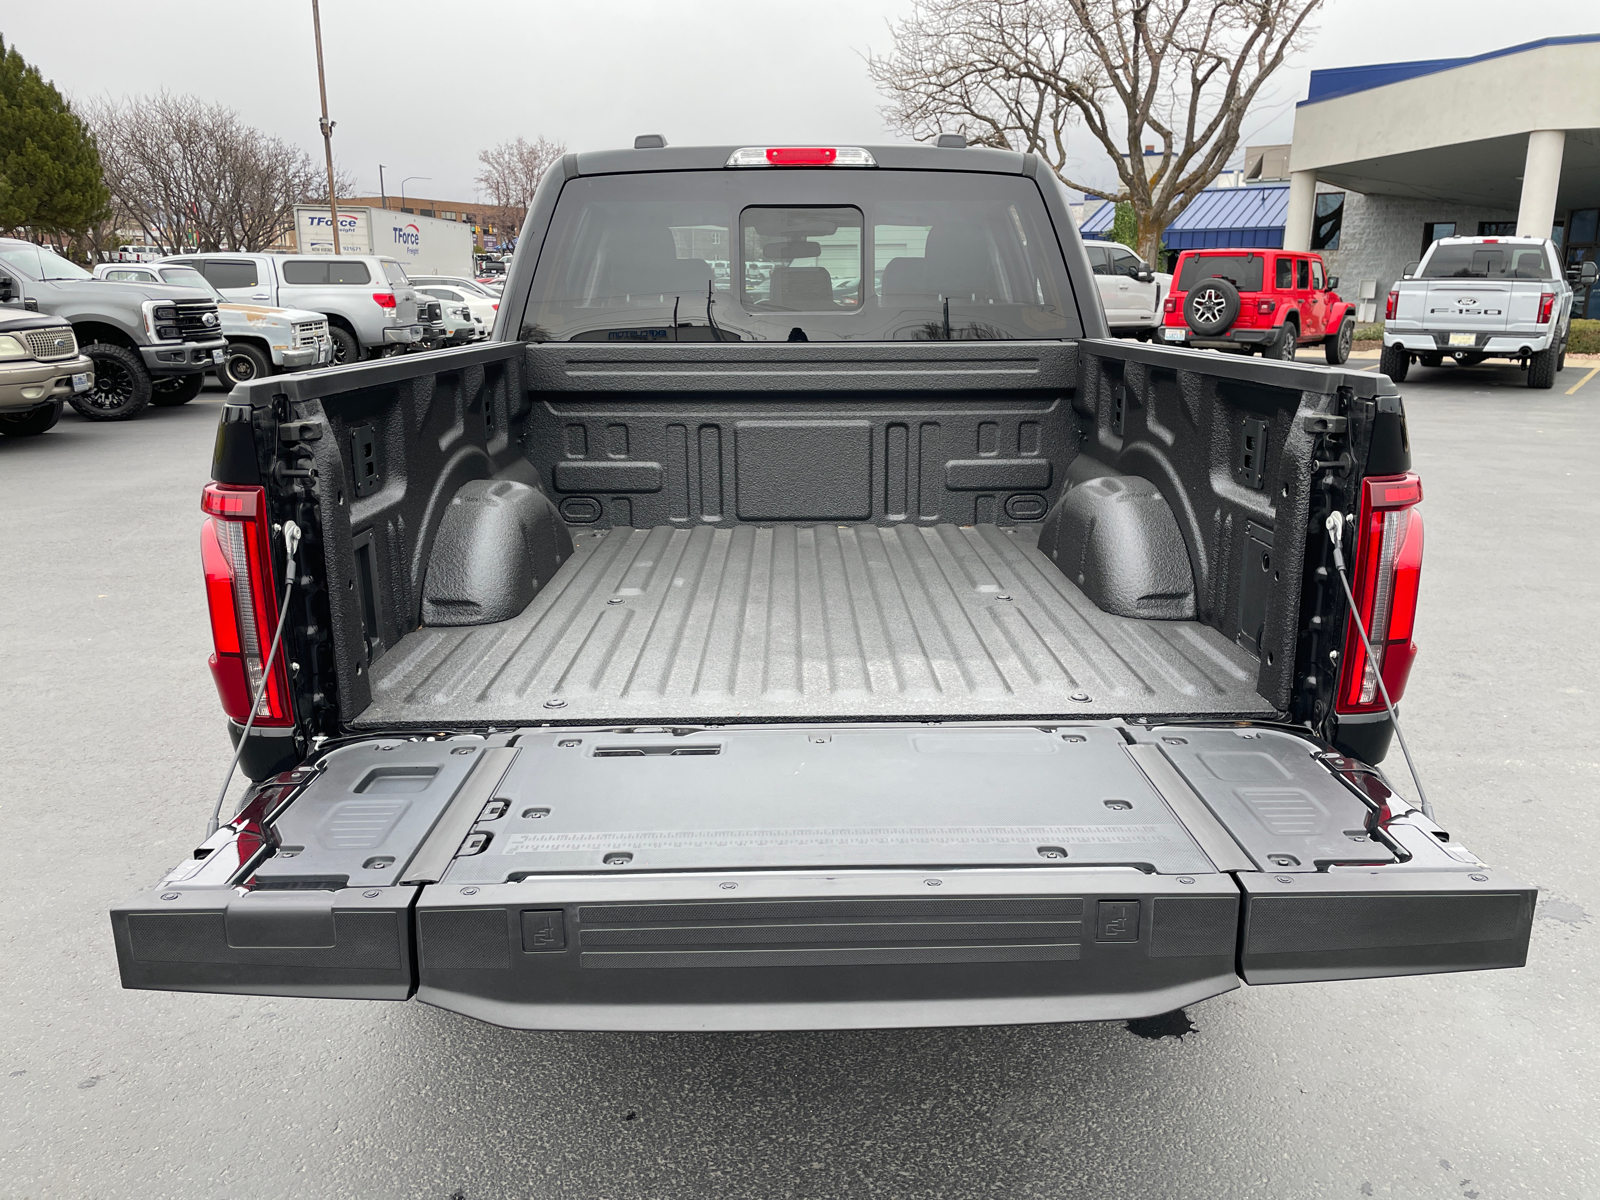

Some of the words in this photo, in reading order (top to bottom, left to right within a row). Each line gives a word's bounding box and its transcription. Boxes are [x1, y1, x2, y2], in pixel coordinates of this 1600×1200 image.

[308, 216, 356, 227] TFoce
[392, 226, 419, 245] TForce
[406, 246, 419, 256] Freight
